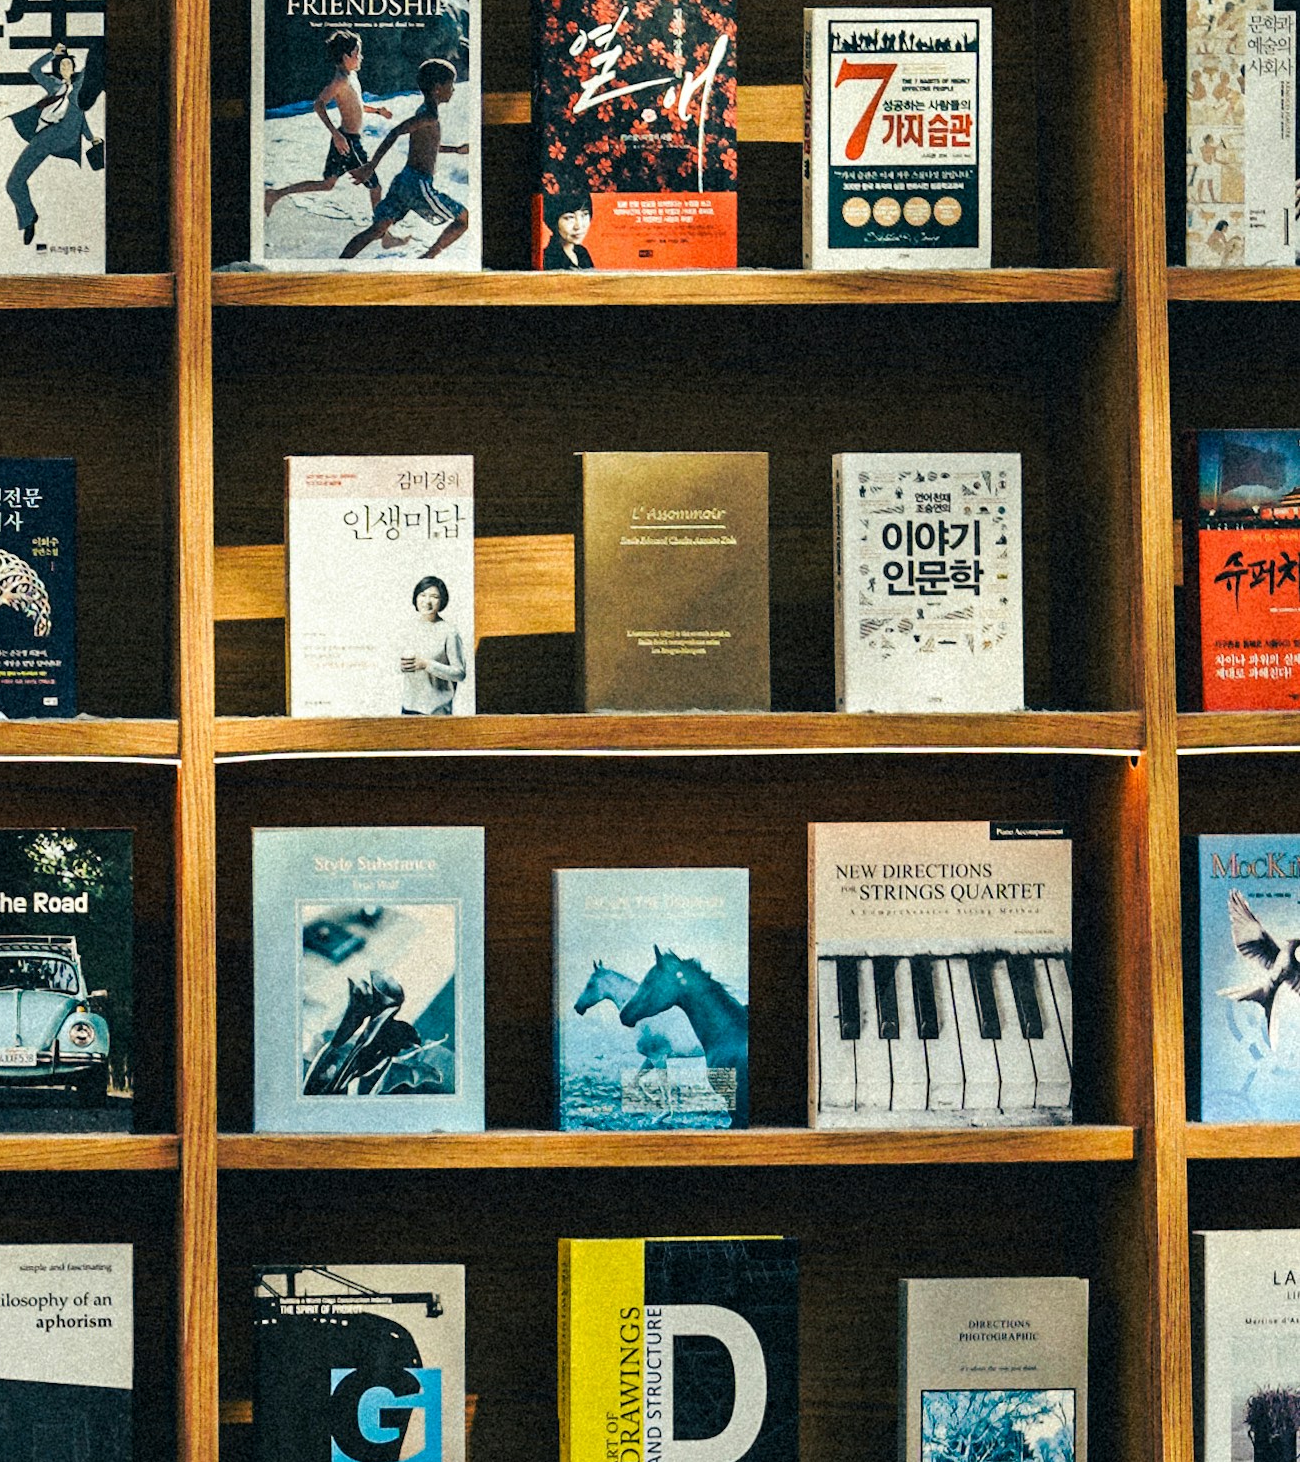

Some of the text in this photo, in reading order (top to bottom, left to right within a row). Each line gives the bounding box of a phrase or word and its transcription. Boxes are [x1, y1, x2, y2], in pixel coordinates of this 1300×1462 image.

[836, 58, 897, 160] 7
[884, 100, 970, 111] 성공하는 사람들의
[882, 114, 972, 147] 가지 습관
[882, 520, 981, 556] 이야기
[883, 559, 984, 596] 인문학
[836, 863, 993, 879] NEW DIRECTIONS
[33, 892, 88, 913] Road
[859, 882, 1045, 903] STRINGS QUARTET
[72, 1292, 89, 1307] of
[93, 1295, 113, 1306] an
[36, 1314, 113, 1333] aphorism
[648, 1307, 662, 1426] STRUCTURE
[606, 1412, 619, 1436] OF
